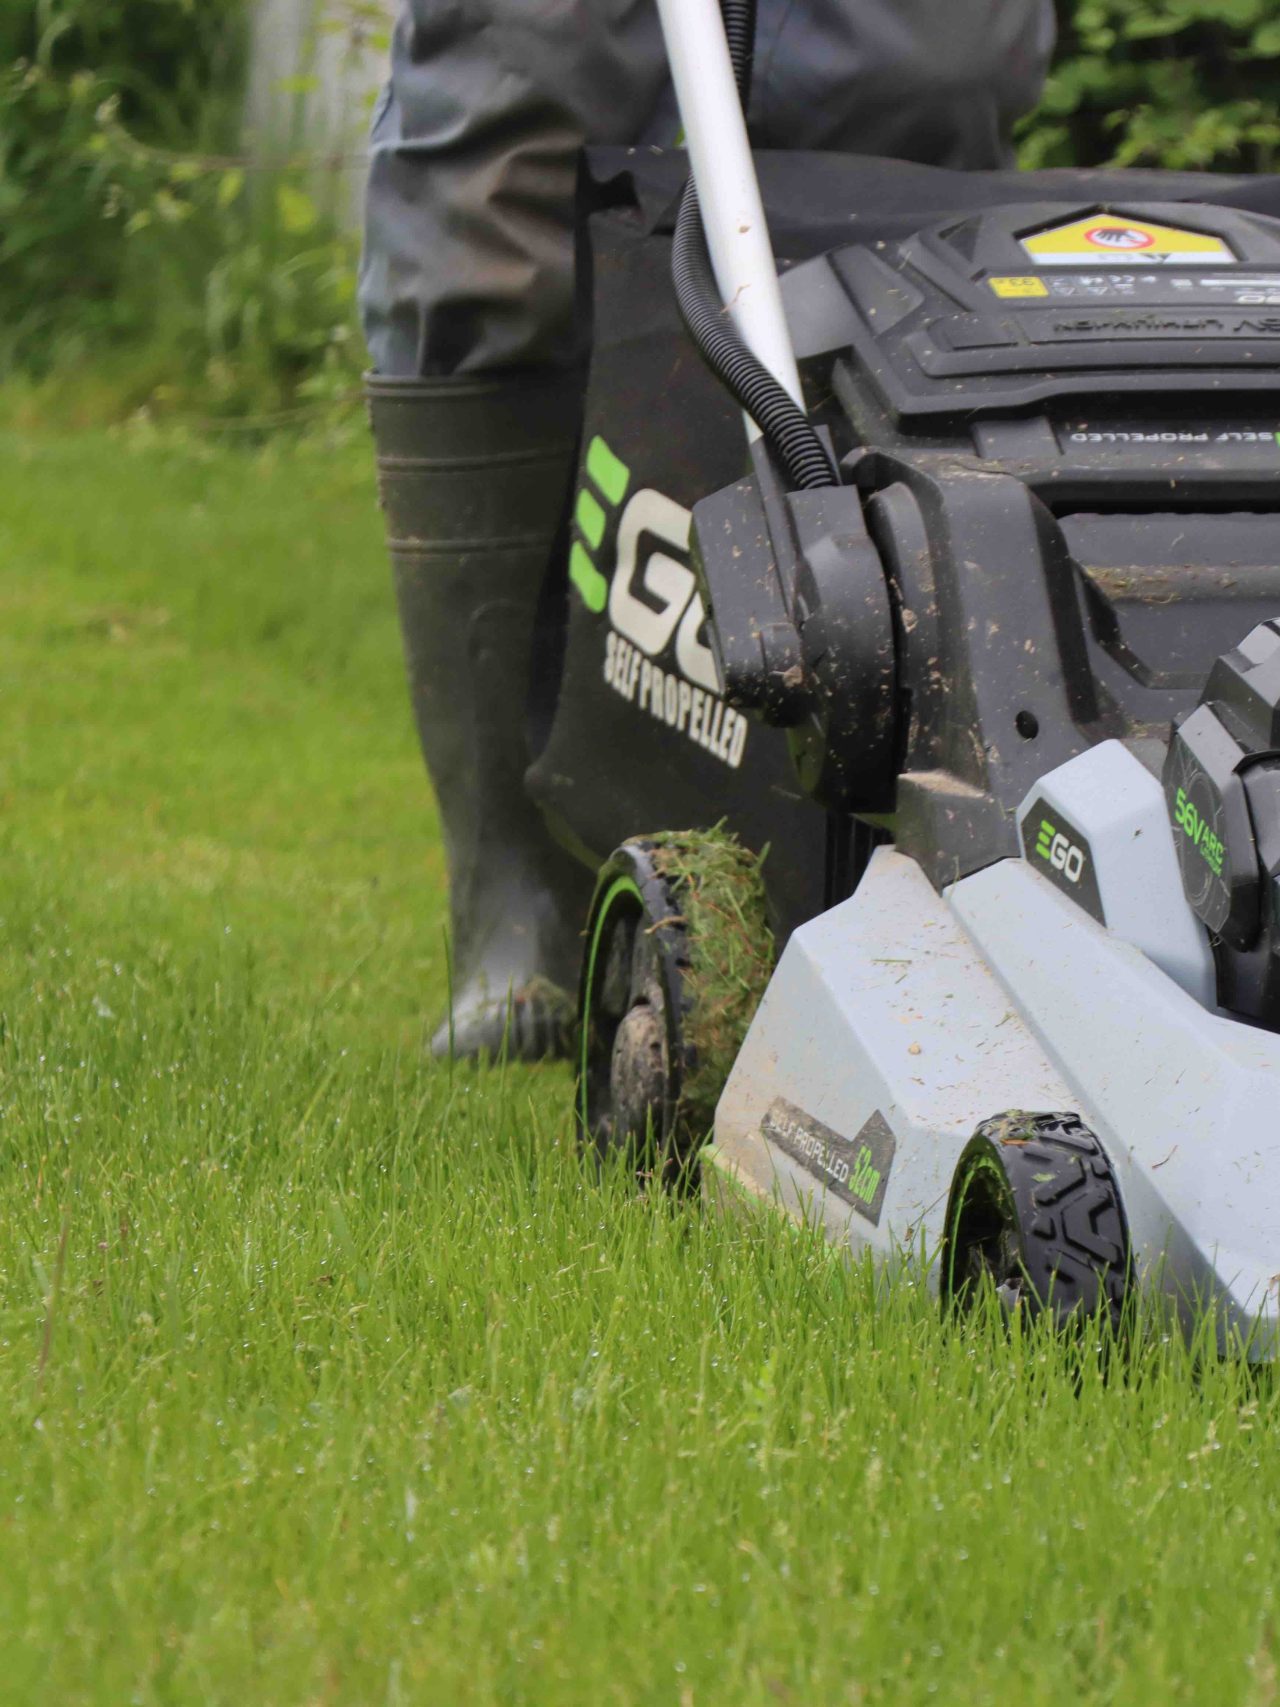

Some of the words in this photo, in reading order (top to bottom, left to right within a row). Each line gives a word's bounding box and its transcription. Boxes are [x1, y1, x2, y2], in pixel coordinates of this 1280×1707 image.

[1070, 432, 1209, 443] PROPELLED
[1215, 432, 1274, 443] SELF
[604, 630, 642, 701] SELF
[638, 658, 748, 768] PROPELLED
[1174, 786, 1205, 845] 56V
[1036, 820, 1083, 883] EGO
[848, 1145, 880, 1205] 52cm
